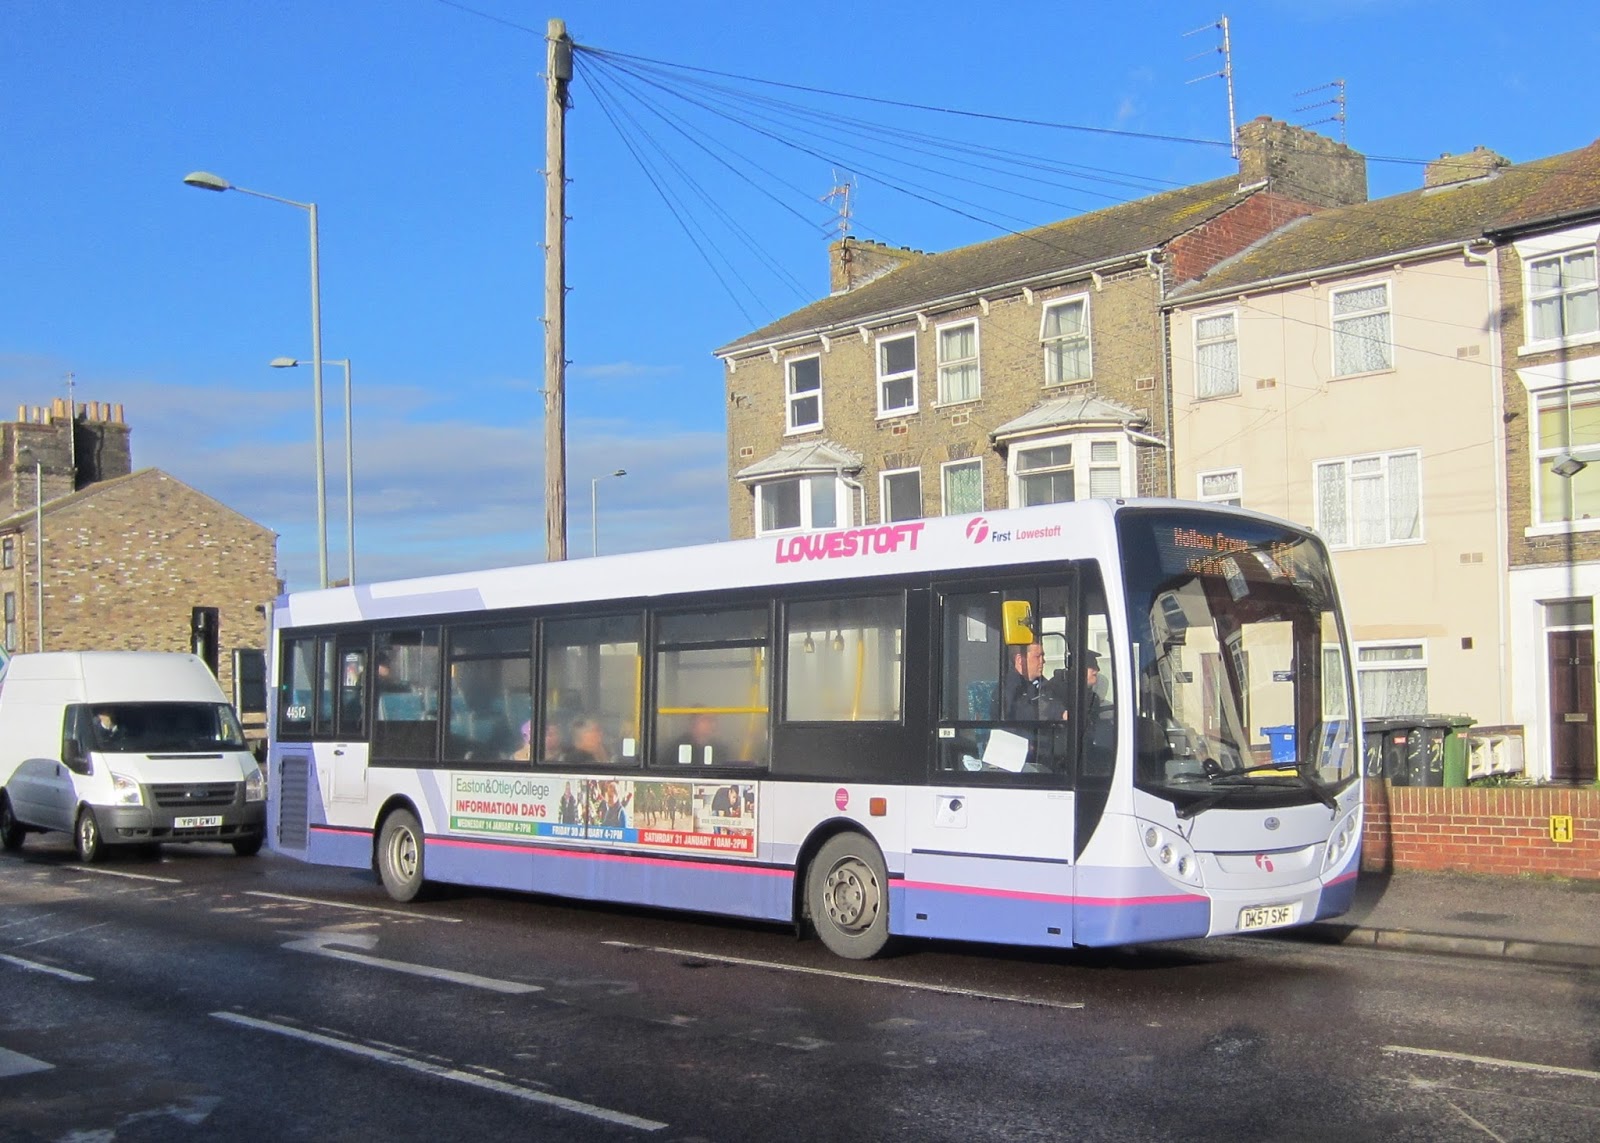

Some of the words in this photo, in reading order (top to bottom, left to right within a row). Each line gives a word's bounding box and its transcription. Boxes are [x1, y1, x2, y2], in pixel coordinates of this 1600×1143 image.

[992, 530, 1011, 542] First
[1016, 525, 1061, 540] Lowestoft
[1173, 528, 1213, 549] Hollow
[775, 523, 925, 564] LOWESTOFT
[1569, 657, 1580, 665] 26
[286, 705, 306, 718] 44512
[456, 778, 549, 800] Easton&OtleyCollege
[456, 800, 518, 816] INFORMATION
[521, 804, 547, 817] DAYS
[457, 818, 485, 829] WEDNESDAY
[493, 821, 514, 831] JANUARY
[515, 822, 532, 833] 4-7PM
[552, 825, 570, 835] FRIDAY
[571, 827, 578, 836] 30
[580, 827, 604, 838] JANUARY
[604, 829, 623, 840] 4-7PM
[644, 832, 673, 844] SATURDAY
[675, 834, 683, 845] 31
[684, 835, 711, 847] JANUARY
[713, 837, 748, 849] 10AM-2PM
[1246, 910, 1269, 927] DK57
[1271, 908, 1289, 923] SXF
